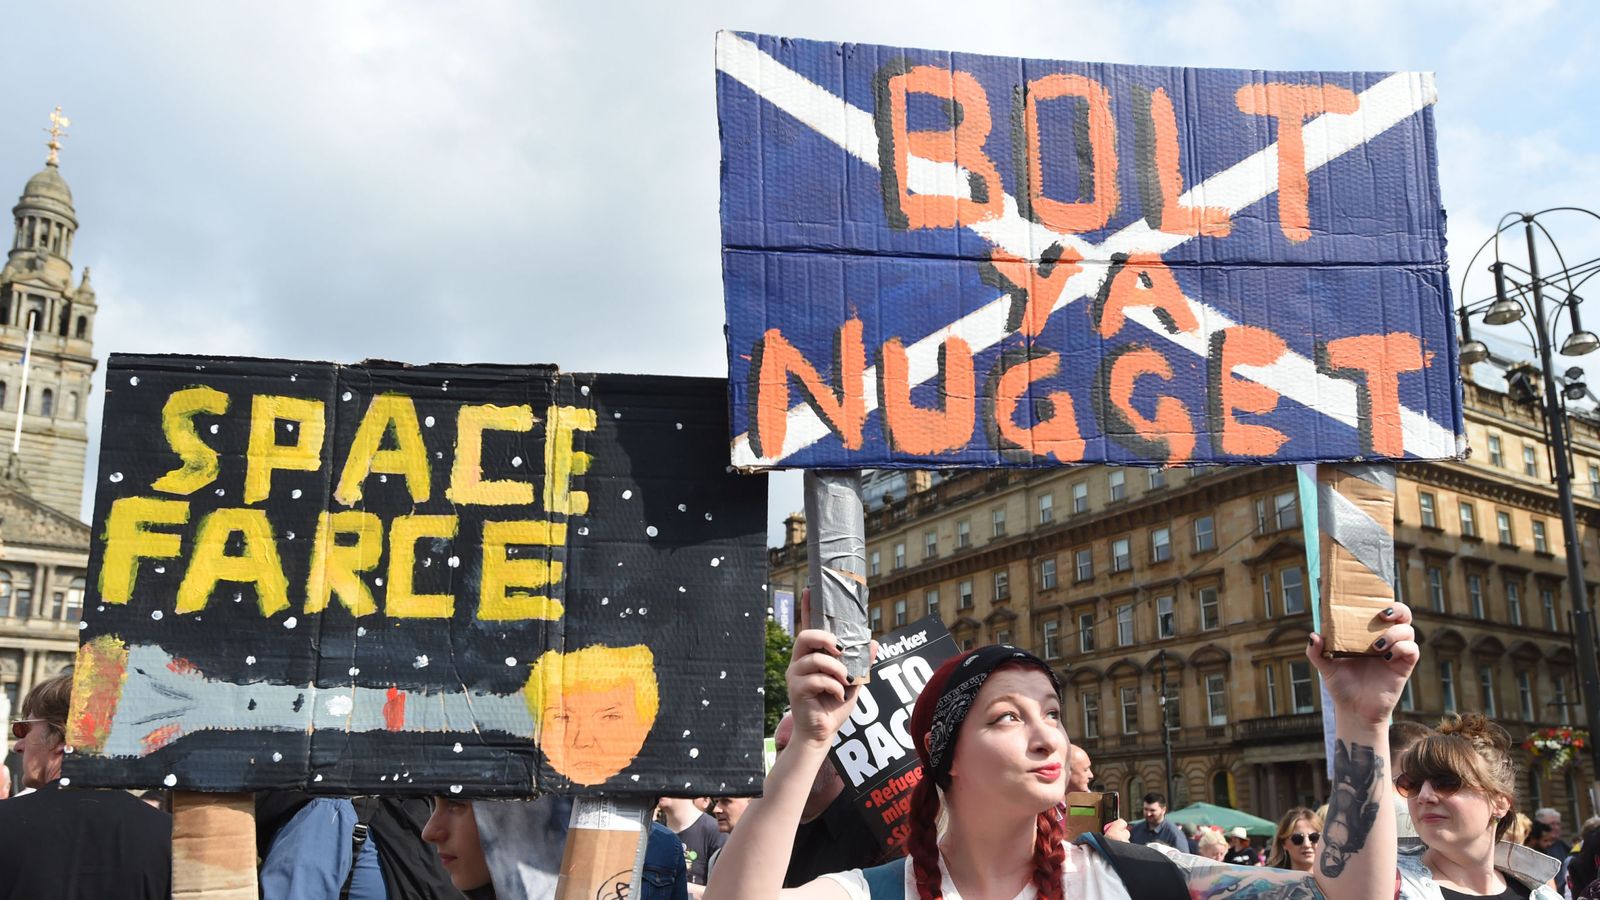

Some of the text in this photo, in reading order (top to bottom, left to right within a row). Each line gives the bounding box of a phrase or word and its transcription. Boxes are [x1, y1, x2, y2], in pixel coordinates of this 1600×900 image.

[874, 58, 1361, 243] BOLT
[981, 241, 1199, 338] YA
[747, 308, 1434, 469] NUGGET
[150, 385, 598, 516] SPACE
[97, 495, 568, 621] FARCE
[876, 629, 928, 661] Worker
[877, 655, 935, 704] TO
[835, 703, 916, 787] RAC
[870, 764, 925, 808] Refuge
